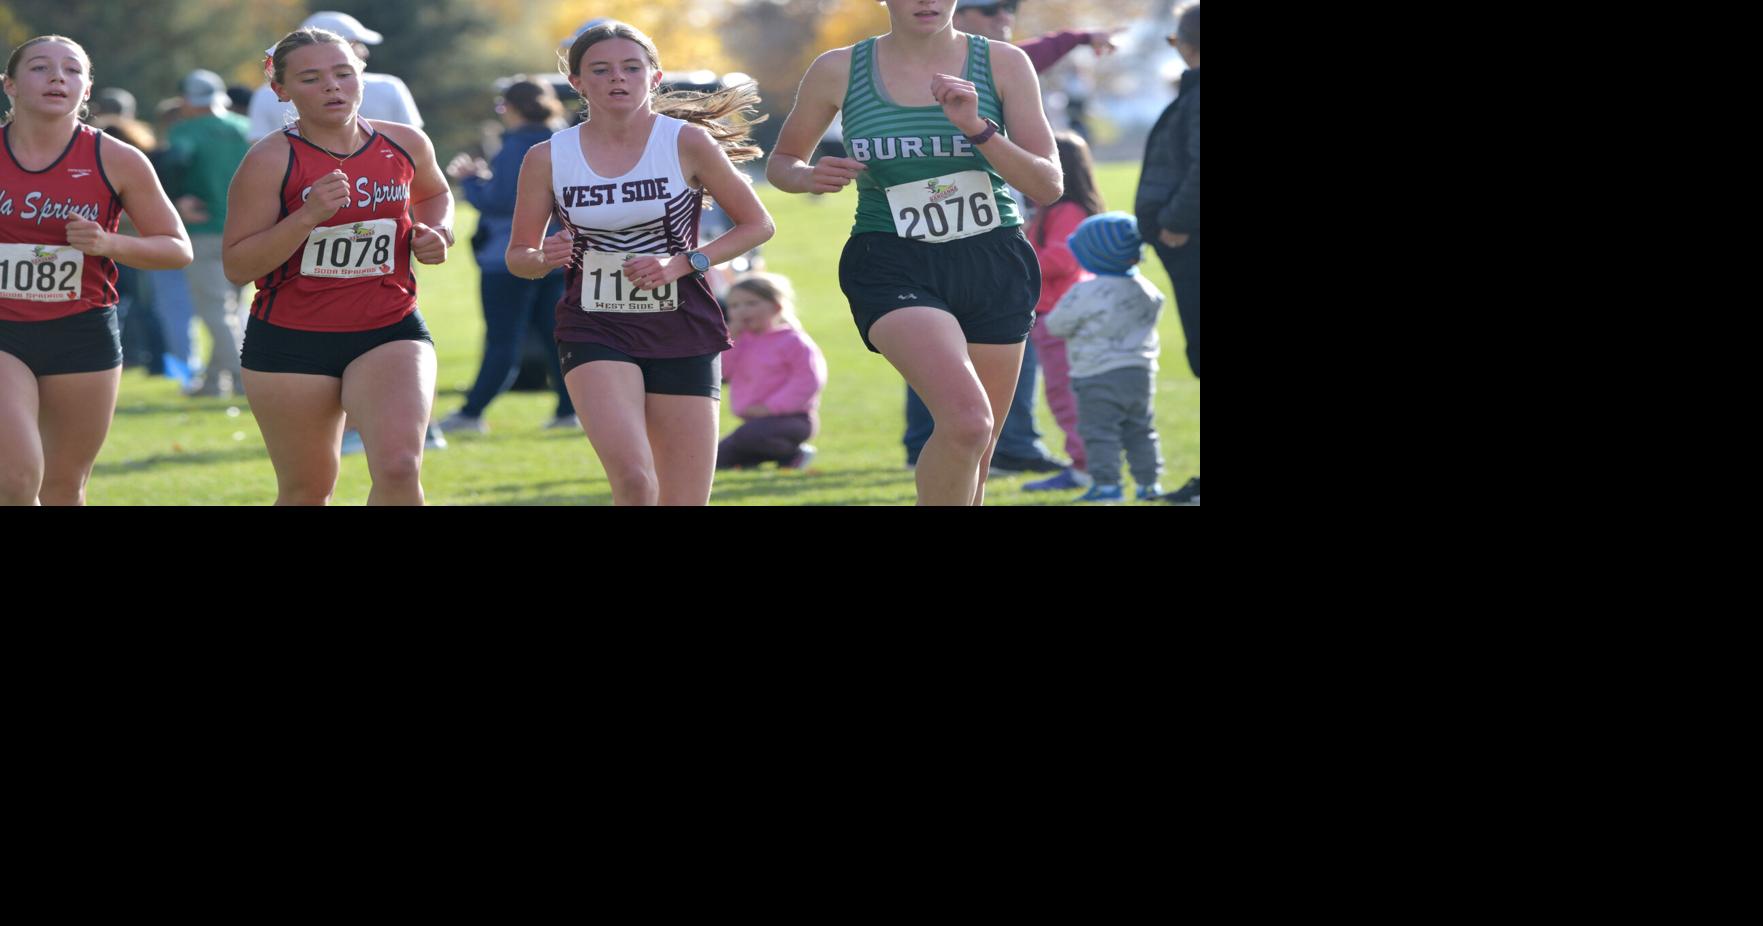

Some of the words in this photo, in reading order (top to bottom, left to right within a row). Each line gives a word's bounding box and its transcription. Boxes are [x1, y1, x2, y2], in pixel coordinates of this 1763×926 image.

[563, 184, 616, 207] WEST
[622, 177, 671, 203] SIDE
[900, 192, 993, 240] 2076
[313, 234, 391, 268] 1078
[0, 259, 77, 292] 1082
[628, 302, 654, 310] SIDE
